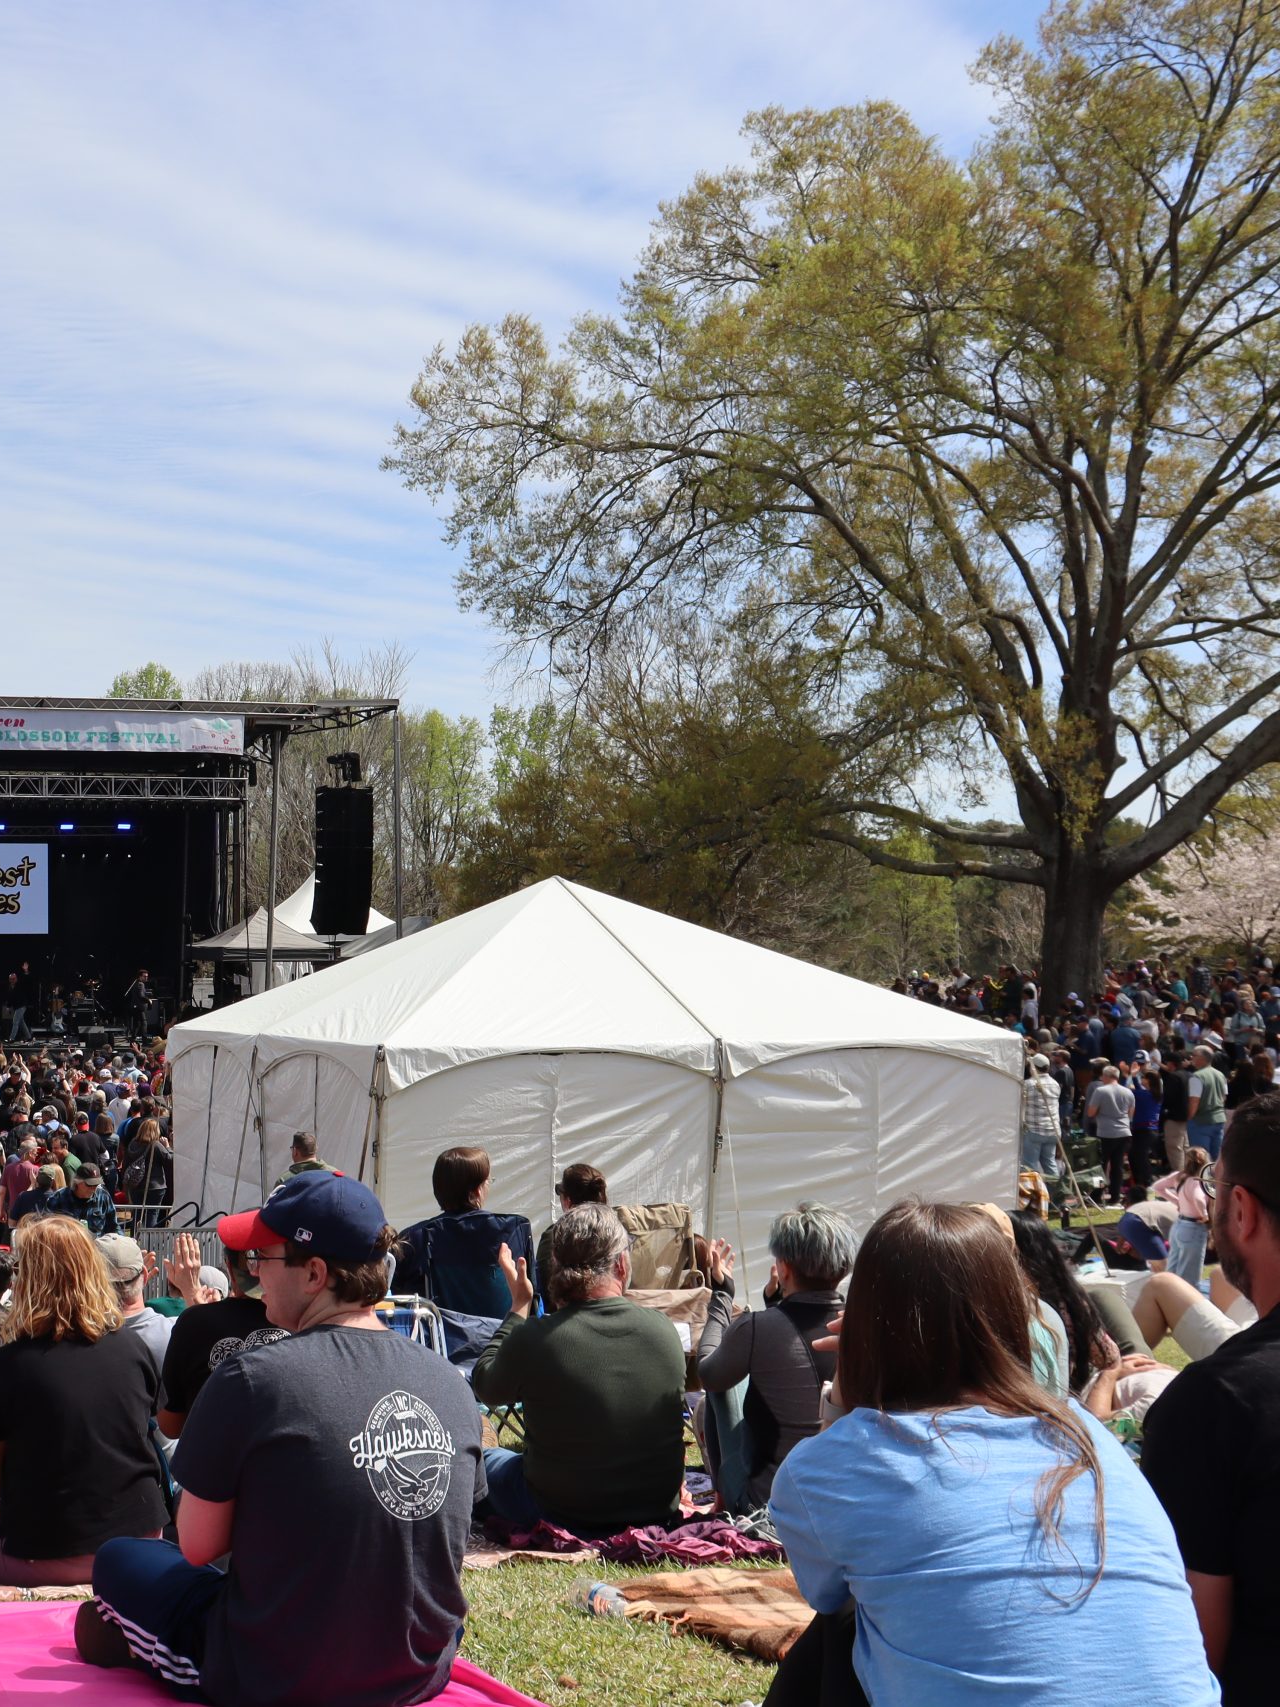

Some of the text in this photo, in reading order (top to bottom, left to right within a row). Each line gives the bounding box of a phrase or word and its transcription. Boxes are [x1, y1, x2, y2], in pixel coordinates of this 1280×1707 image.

[86, 731, 181, 744] FESTIVAL
[370, 1400, 390, 1430] GENUINE
[395, 1395, 408, 1411] NC
[414, 1401, 441, 1432] AUTHENTIC
[349, 1422, 456, 1469] Hawksnest
[380, 1489, 444, 1517] SEVEN DEVILS
